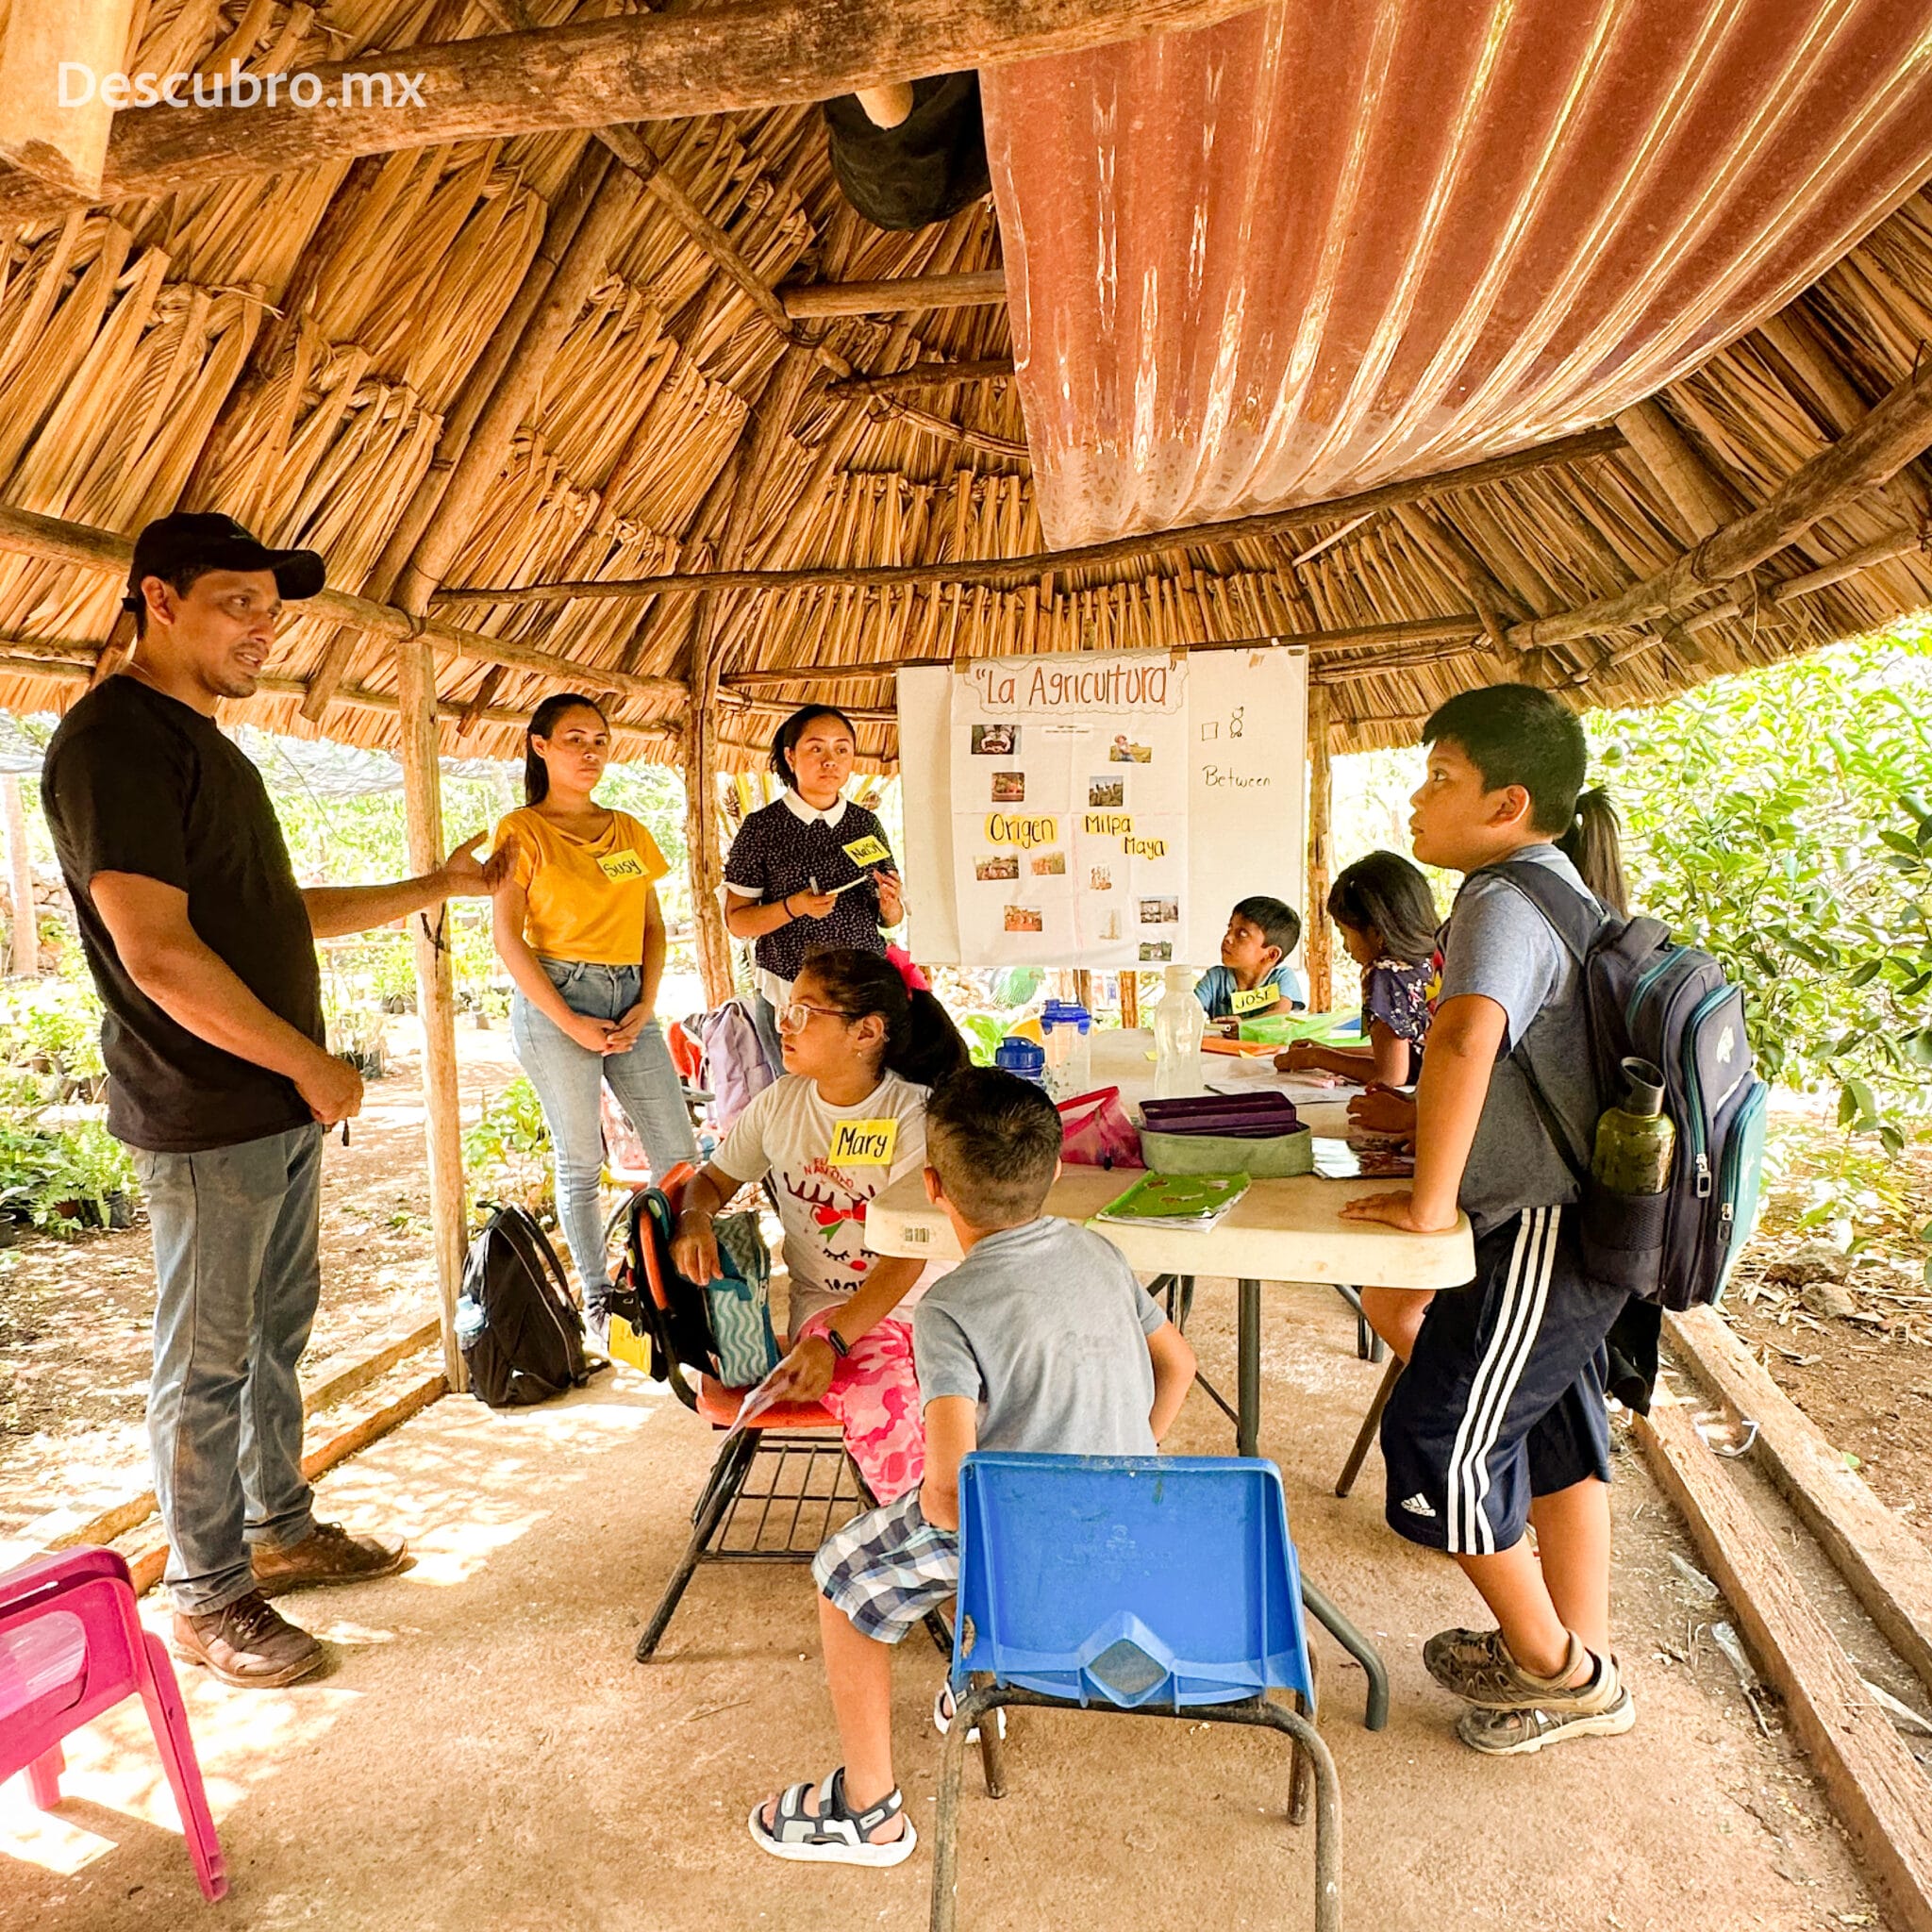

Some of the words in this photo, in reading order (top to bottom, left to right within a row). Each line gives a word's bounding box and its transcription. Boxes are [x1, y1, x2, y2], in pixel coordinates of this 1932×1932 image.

[1202, 764, 1271, 788] Between
[990, 813, 1055, 849] Origen
[1124, 836, 1165, 860] Maya
[603, 858, 642, 877] Susy
[837, 1125, 889, 1158] Mary
